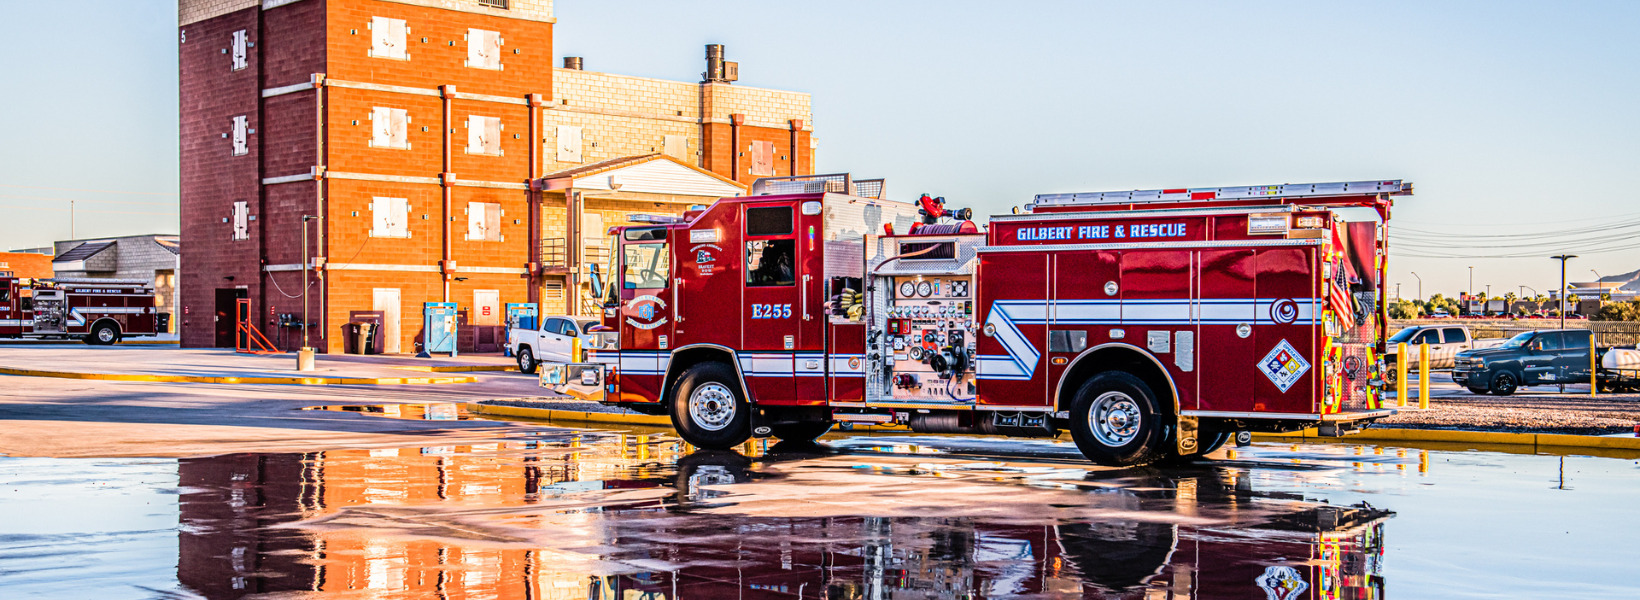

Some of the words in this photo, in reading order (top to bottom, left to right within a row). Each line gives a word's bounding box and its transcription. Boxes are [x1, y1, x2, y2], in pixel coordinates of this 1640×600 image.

[181, 30, 186, 43] 5
[1017, 227, 1073, 241] GILBERT
[1078, 225, 1109, 239] FIRE
[1114, 225, 1125, 238] &
[1130, 223, 1187, 238] RESCUE
[751, 303, 792, 319] E255
[1266, 347, 1281, 363] SPECIAL
[1283, 344, 1305, 367] OPERATIONS
